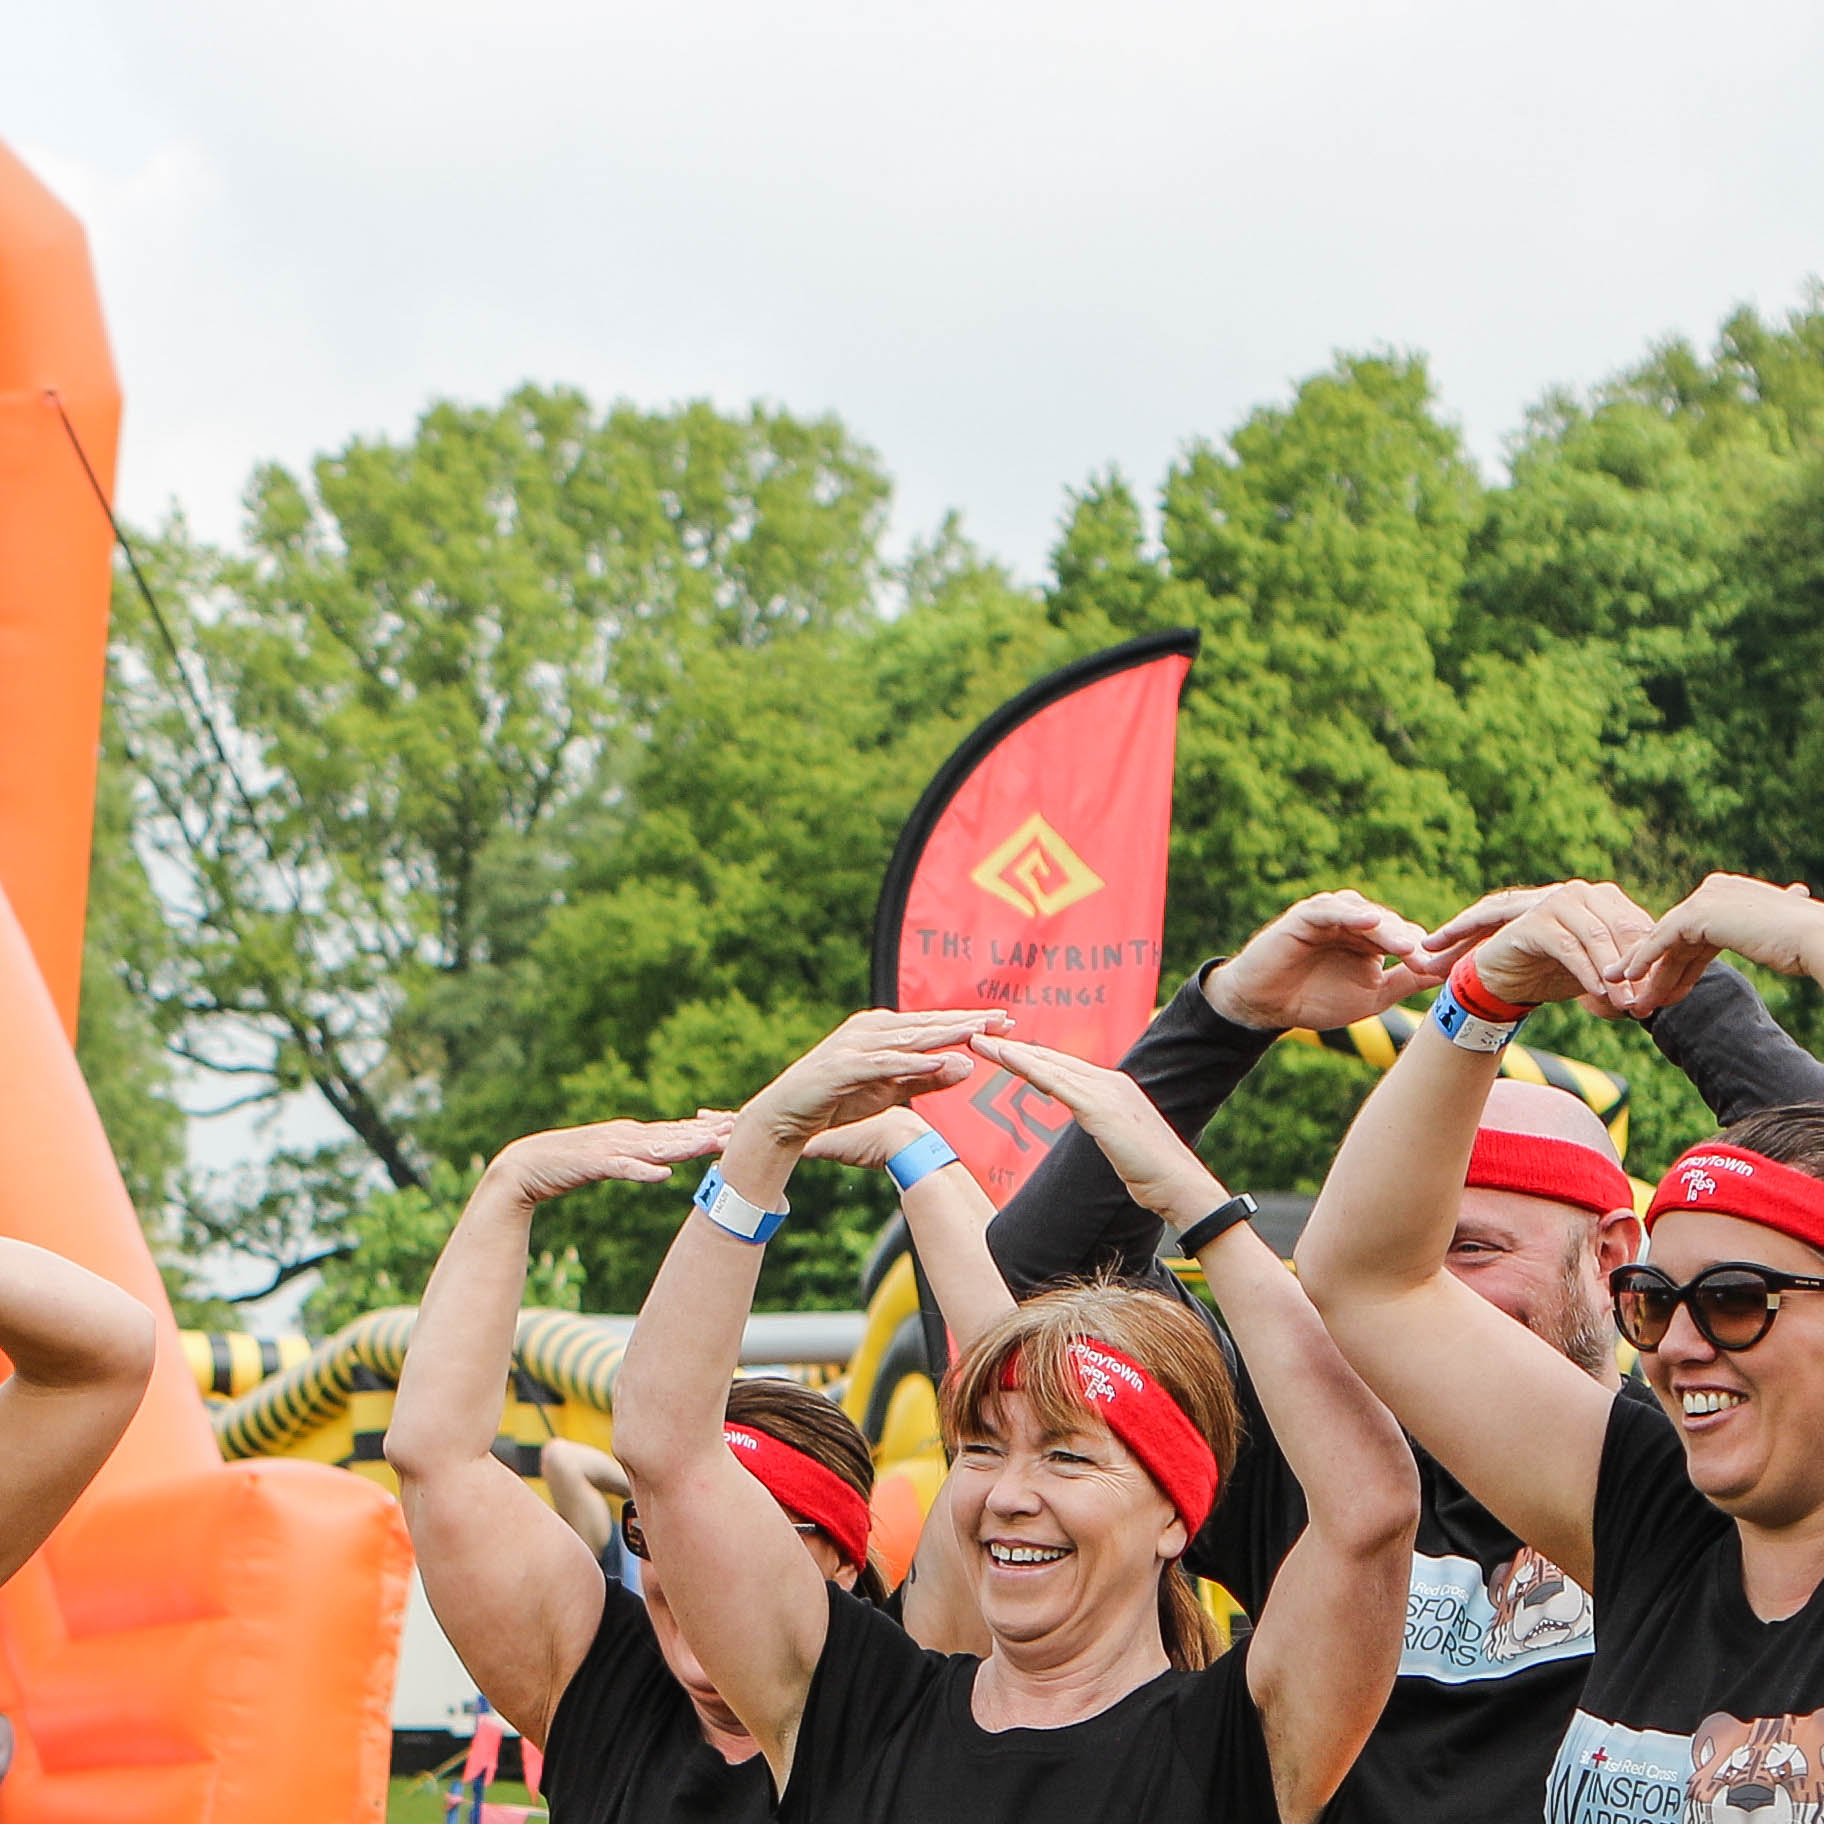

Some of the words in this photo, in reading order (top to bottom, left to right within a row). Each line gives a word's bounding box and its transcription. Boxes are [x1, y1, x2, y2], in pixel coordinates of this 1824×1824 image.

[916, 929, 972, 960] THE
[977, 979, 1106, 1007] CHALLENGE
[1407, 1594, 1482, 1642] SFORD
[1404, 1622, 1477, 1667] RIORS
